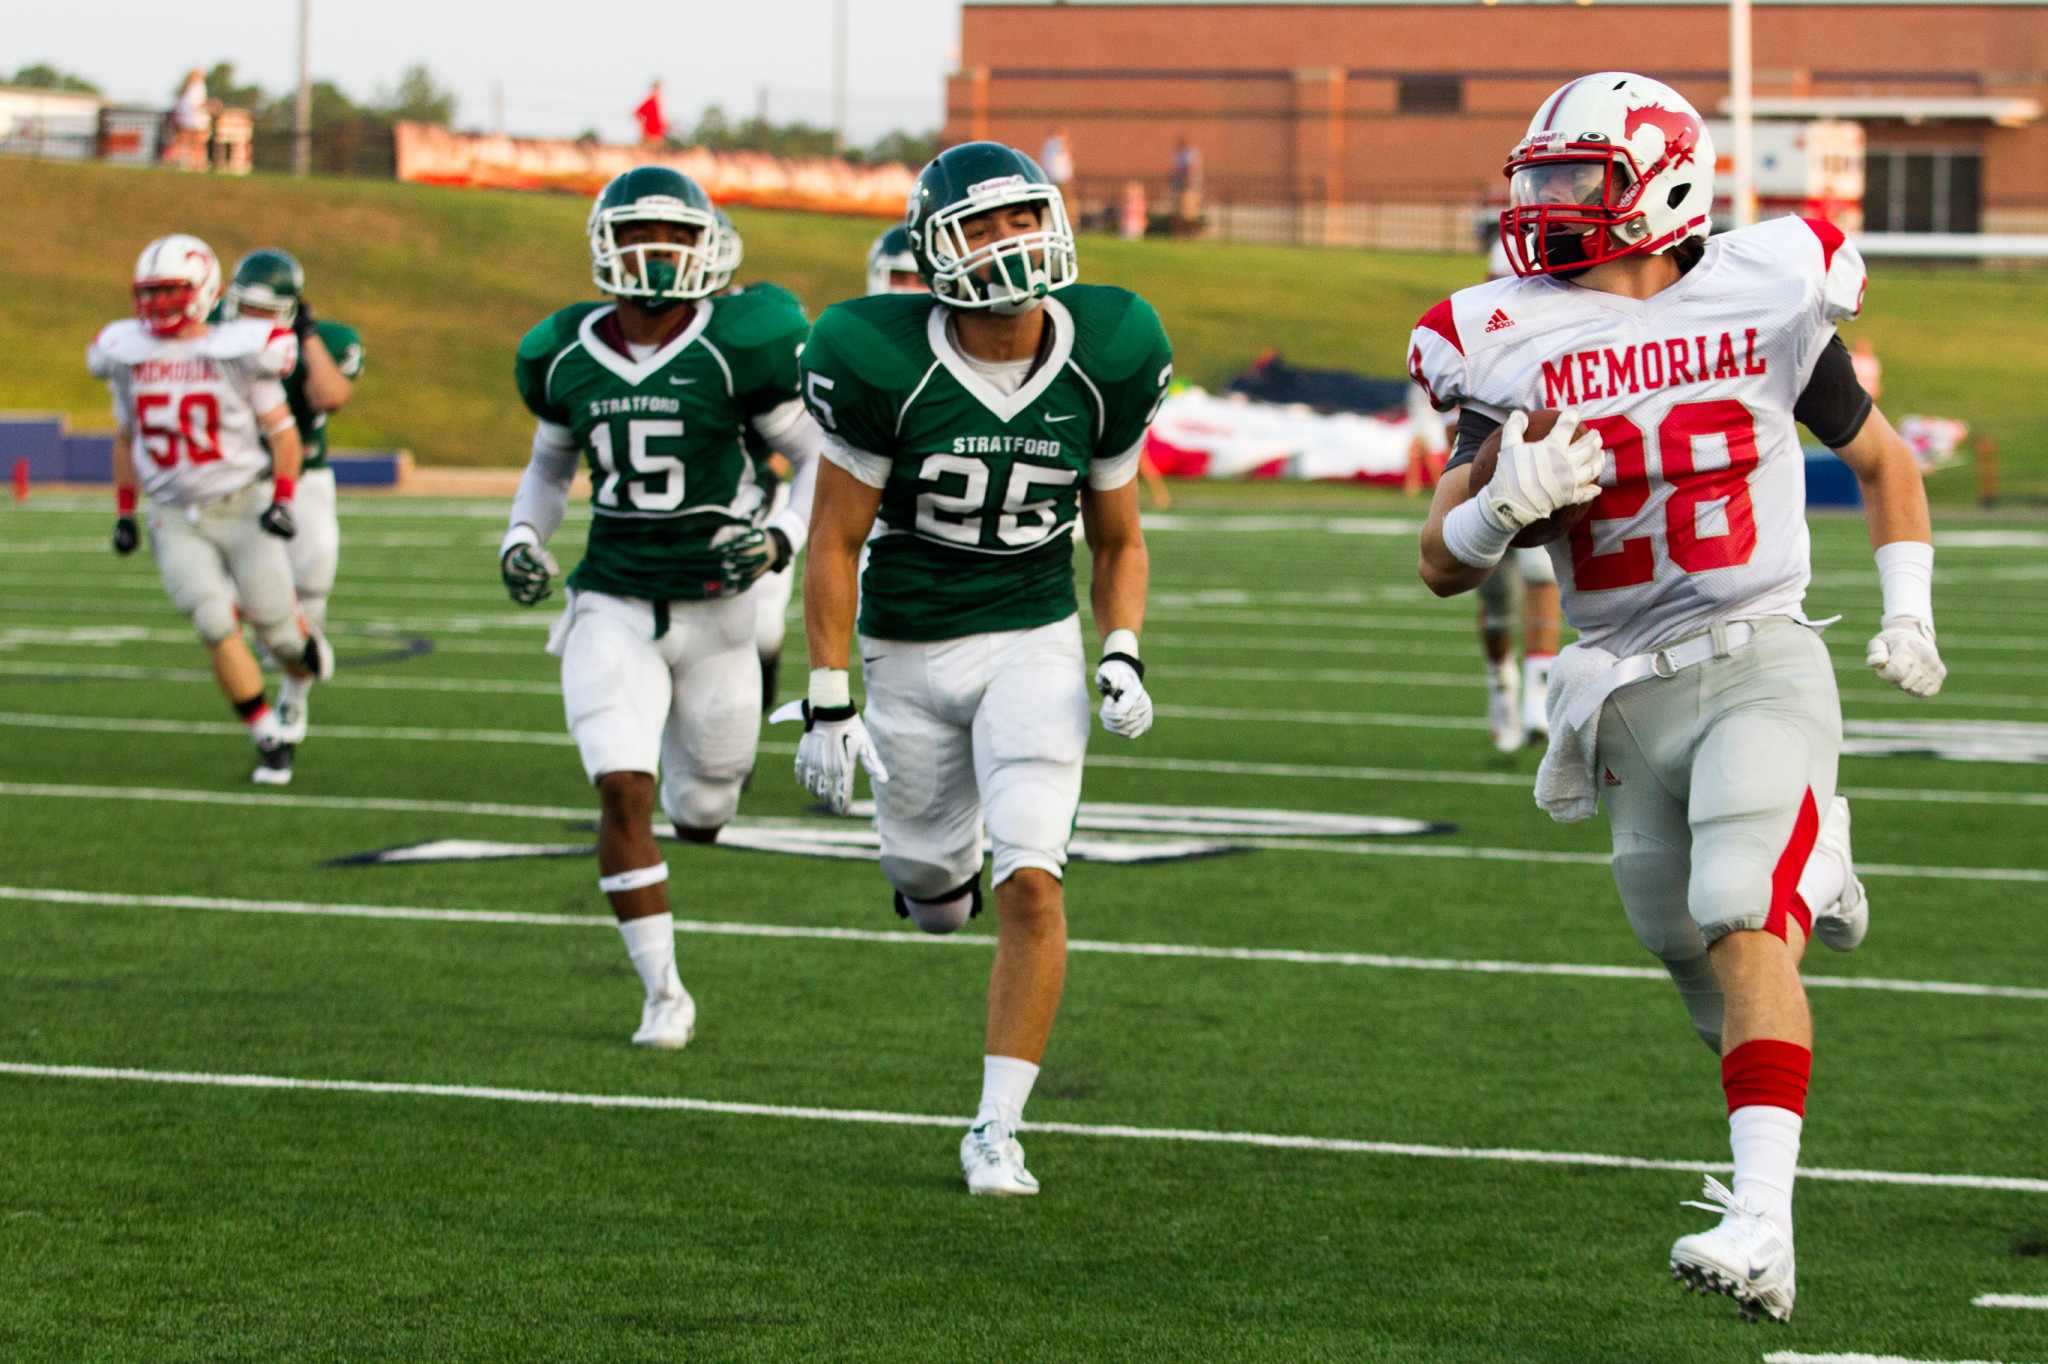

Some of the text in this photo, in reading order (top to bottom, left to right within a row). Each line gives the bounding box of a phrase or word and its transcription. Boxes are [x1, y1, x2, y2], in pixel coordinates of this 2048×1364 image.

[1484, 320, 1516, 333] adidas
[589, 396, 680, 417] STRATFORD
[1541, 328, 1767, 408] MEMORIAL
[136, 392, 224, 470] 50
[589, 419, 685, 511] 15
[952, 435, 1061, 458] STRATFORD
[915, 453, 1078, 546] 25
[1572, 398, 1760, 592] 28
